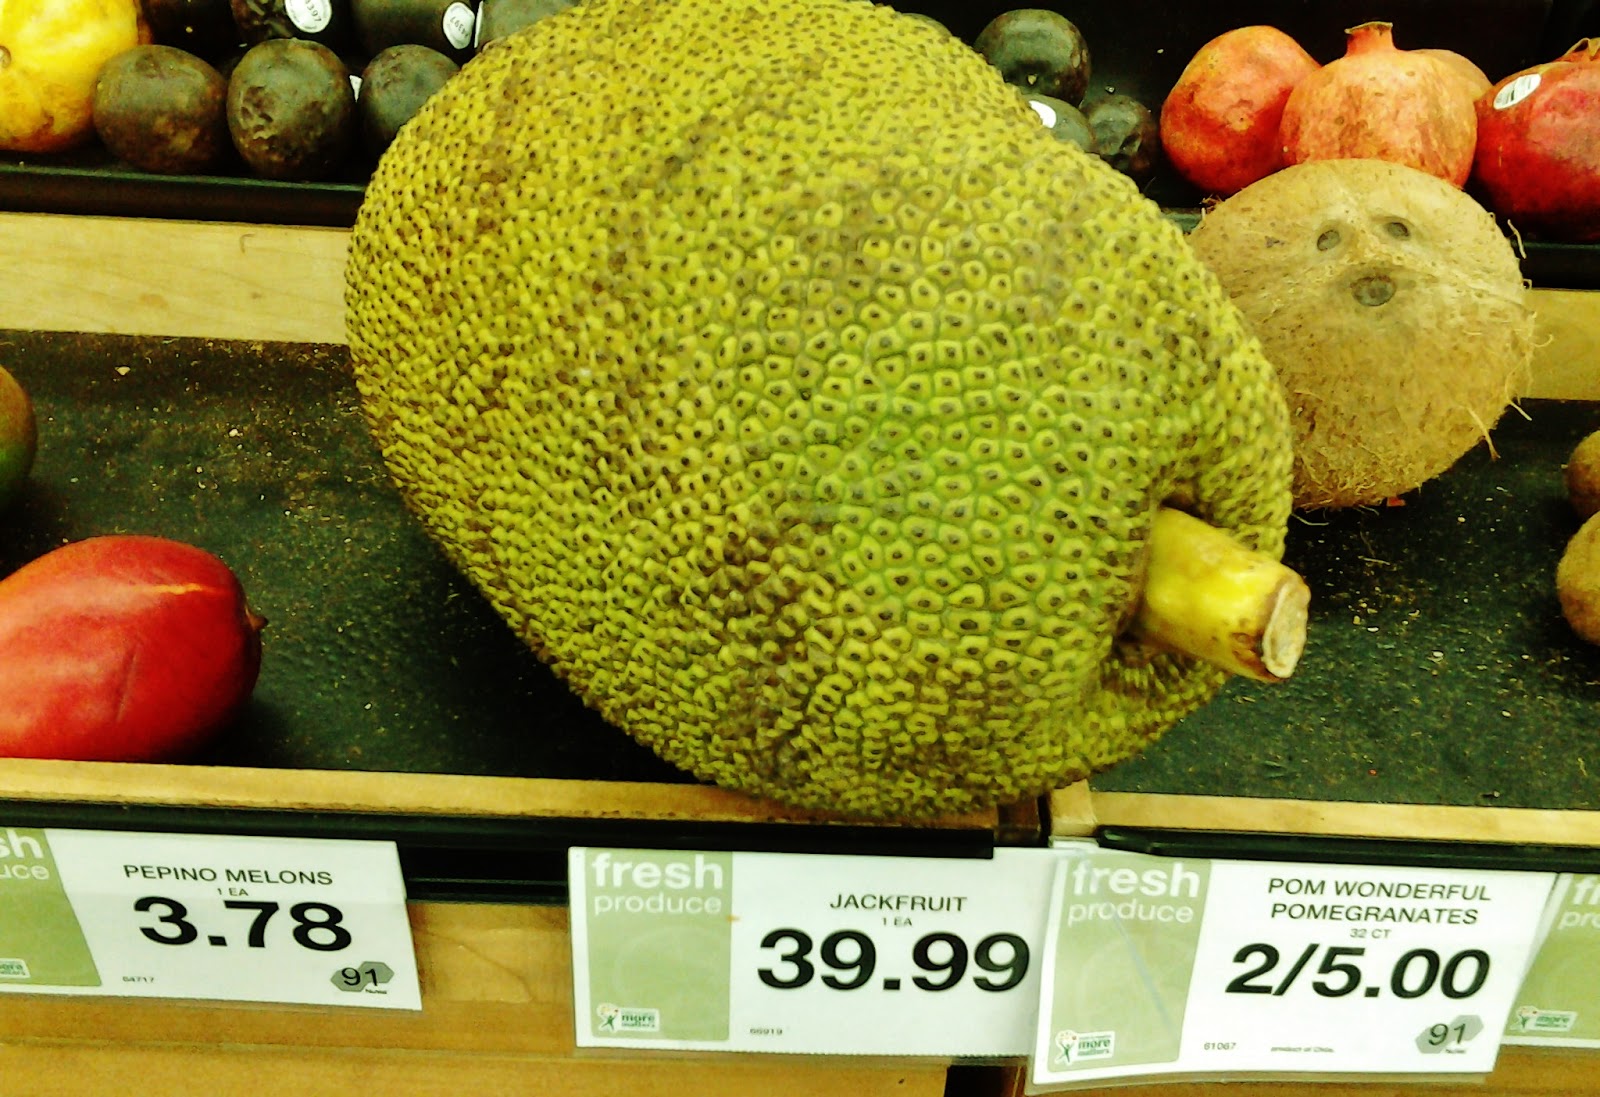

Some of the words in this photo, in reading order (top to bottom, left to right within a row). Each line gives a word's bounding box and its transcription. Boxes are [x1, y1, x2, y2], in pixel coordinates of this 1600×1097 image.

[123, 864, 217, 882] PEPINO
[225, 868, 334, 886] MELONS
[592, 852, 724, 890] fresh
[1073, 860, 1200, 898] fresh
[228, 887, 249, 897] EA
[1267, 877, 1326, 896] POM
[1334, 880, 1493, 902] WONDERFUL
[594, 891, 723, 917] produce
[829, 893, 968, 912] JACKFRUIT
[1067, 898, 1194, 928] produce
[1270, 902, 1479, 925] POMEGRANATES
[133, 896, 352, 952] 3.78
[893, 917, 913, 927] EA
[1349, 928, 1366, 939] 32
[1371, 928, 1392, 939] CT
[757, 928, 1031, 993] 39.99
[1225, 943, 1491, 1000] 2/5.00
[341, 967, 378, 987] 91
[1078, 1039, 1111, 1050] more
[1428, 1023, 1466, 1046] 91
[1203, 1042, 1237, 1051] 61067
